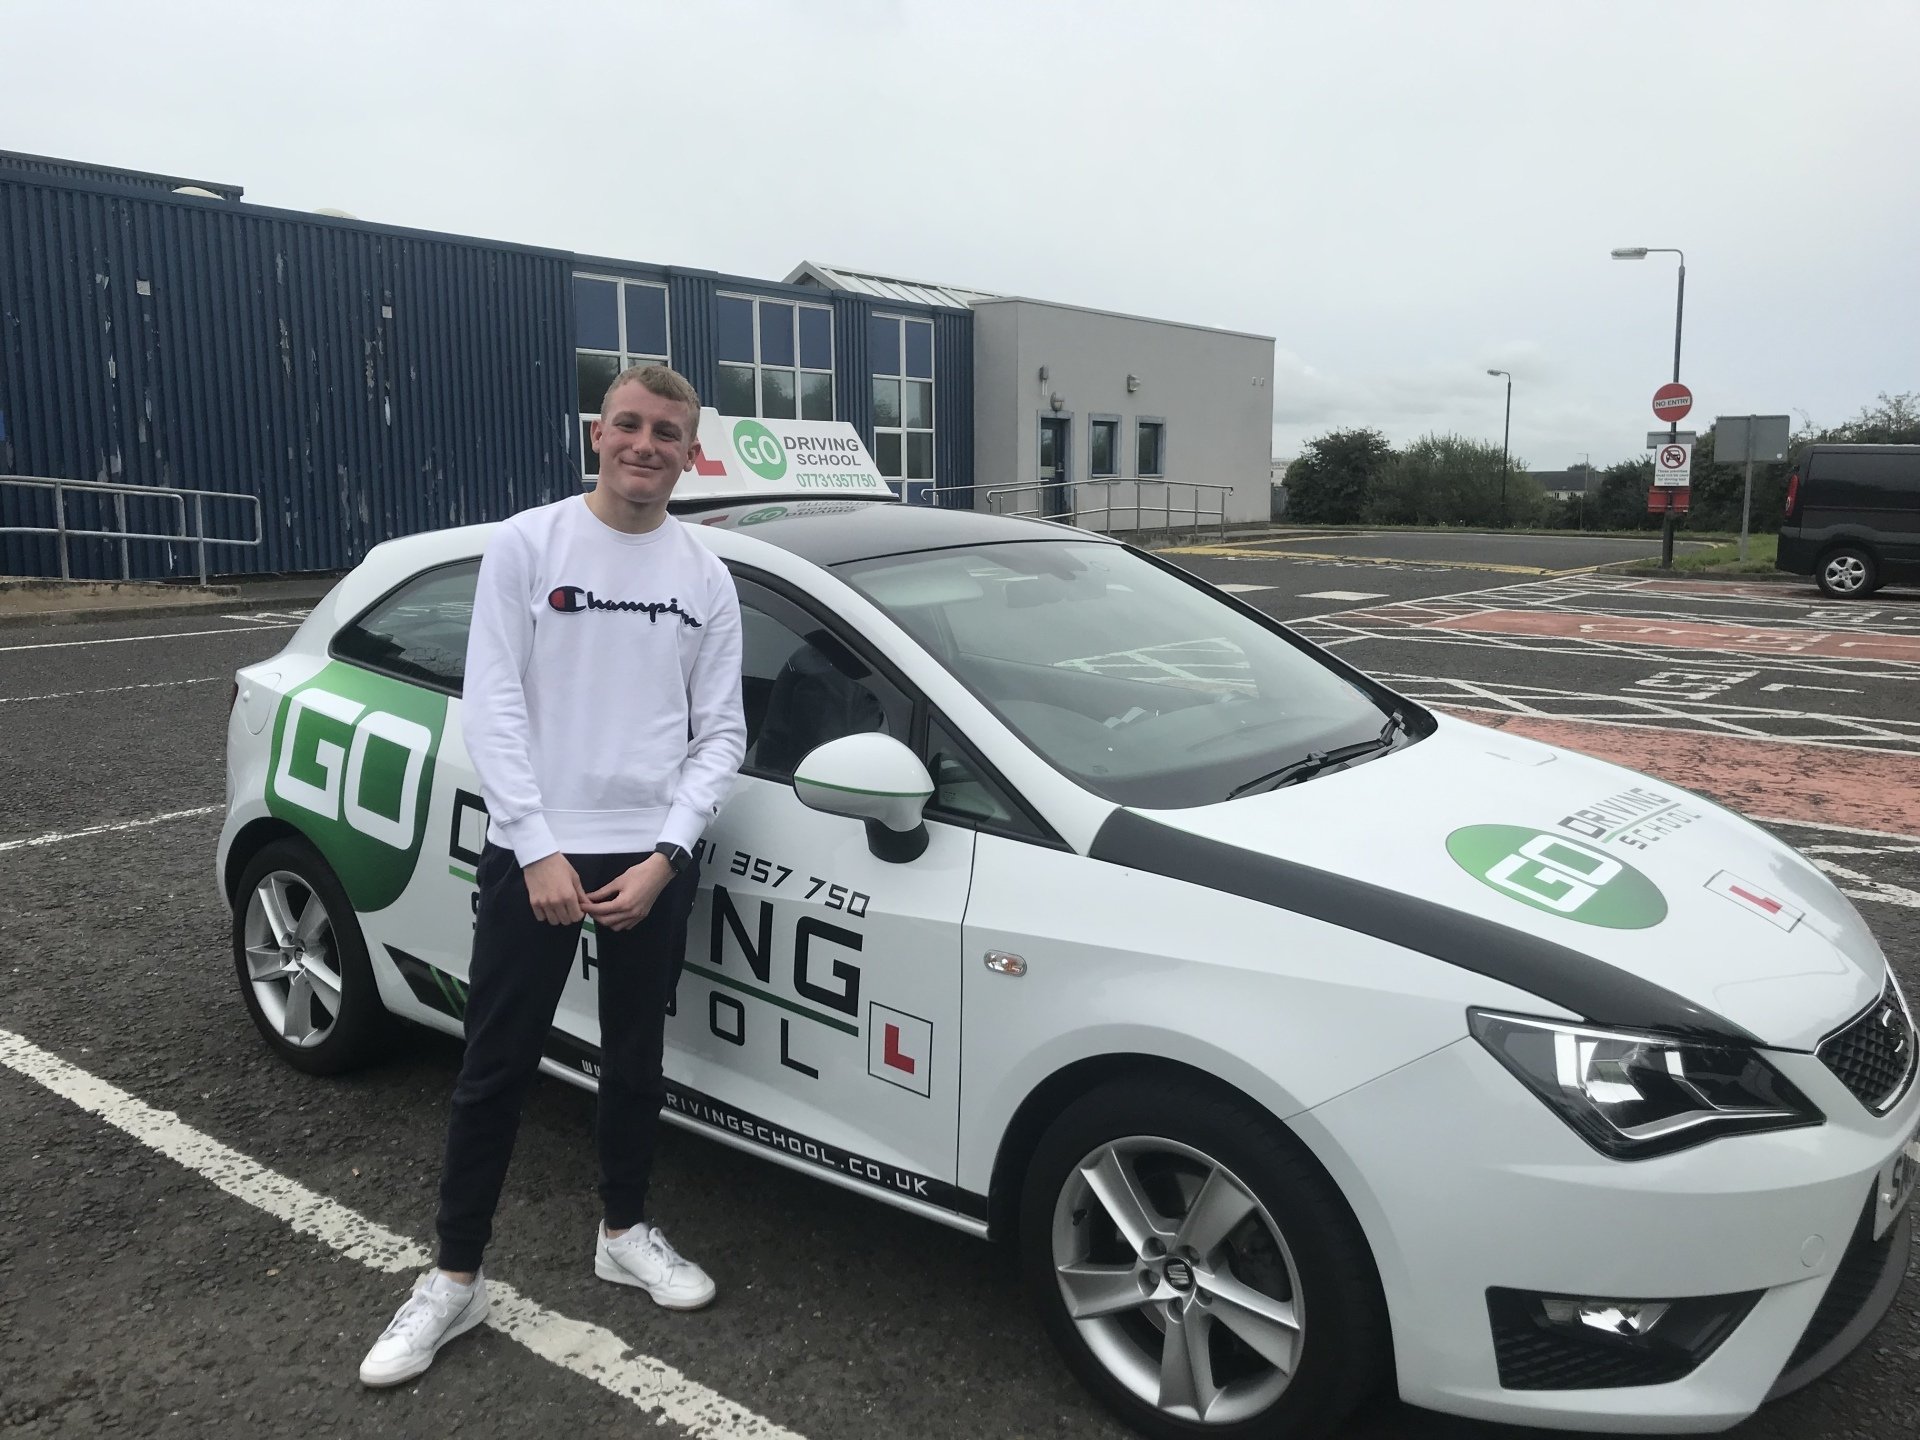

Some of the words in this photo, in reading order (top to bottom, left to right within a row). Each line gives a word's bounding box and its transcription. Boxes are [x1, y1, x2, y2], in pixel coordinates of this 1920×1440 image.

[1655, 400, 1666, 408] NO
[1667, 398, 1689, 406] ENTRY
[738, 434, 782, 465] GO
[783, 436, 859, 452] DRIVING
[797, 453, 861, 467] SCHOOL
[796, 473, 877, 488] 07731357750
[547, 585, 703, 628] Champin
[274, 687, 432, 851] GO
[1557, 787, 1672, 840] DRIVING
[1618, 809, 1702, 850] SCHOOL
[730, 851, 794, 888] 357
[804, 876, 870, 918] 750
[1485, 834, 1623, 913] GO
[884, 1023, 915, 1075] L
